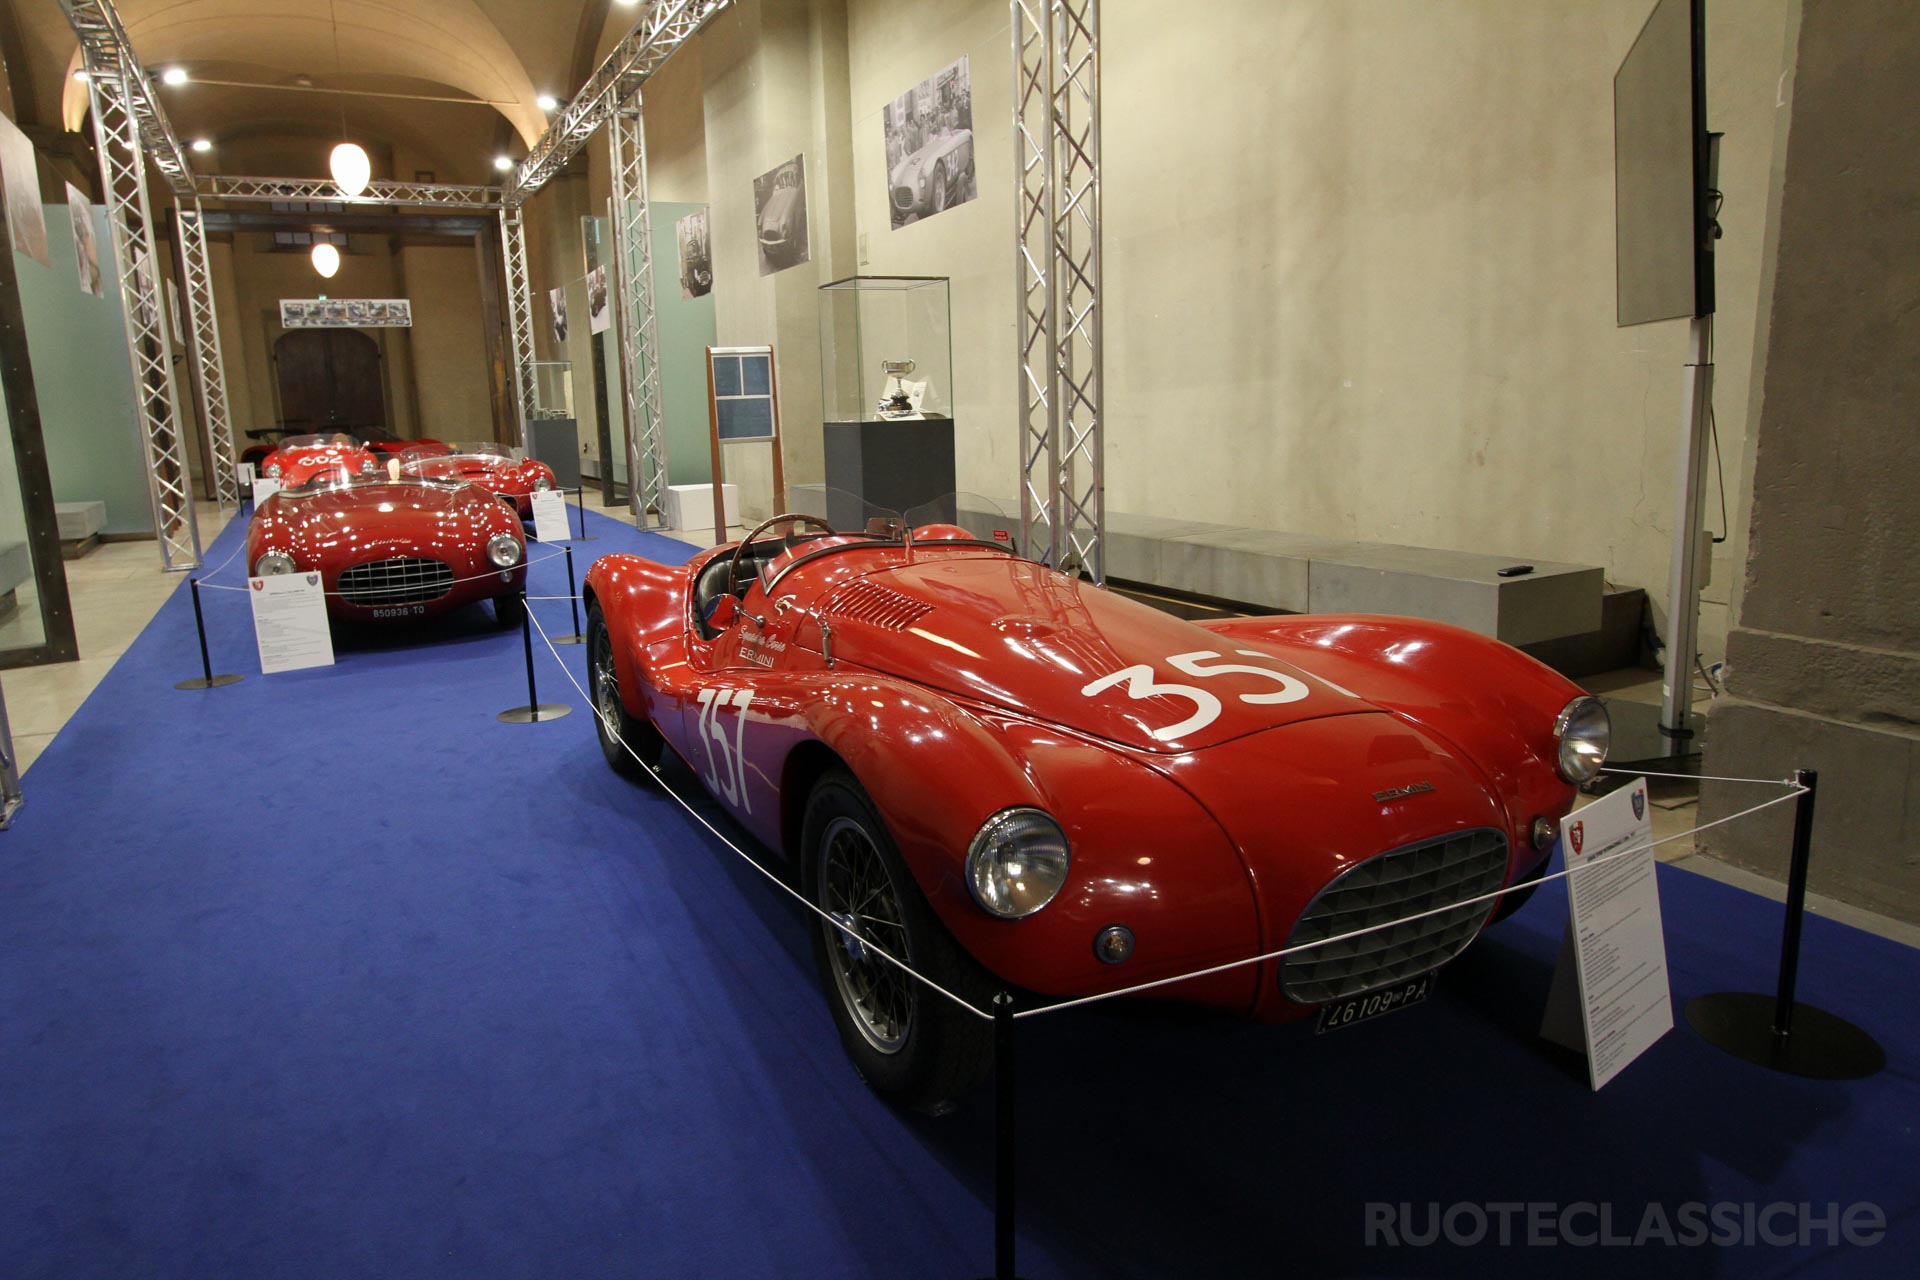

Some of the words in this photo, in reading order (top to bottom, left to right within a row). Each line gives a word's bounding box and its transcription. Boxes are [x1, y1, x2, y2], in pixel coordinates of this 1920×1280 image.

[739, 646, 775, 668] ERMINI
[1081, 649, 1361, 741] 35
[697, 688, 755, 816] 357
[1328, 991, 1393, 1026] 46109
[1402, 979, 1428, 1004] PA
